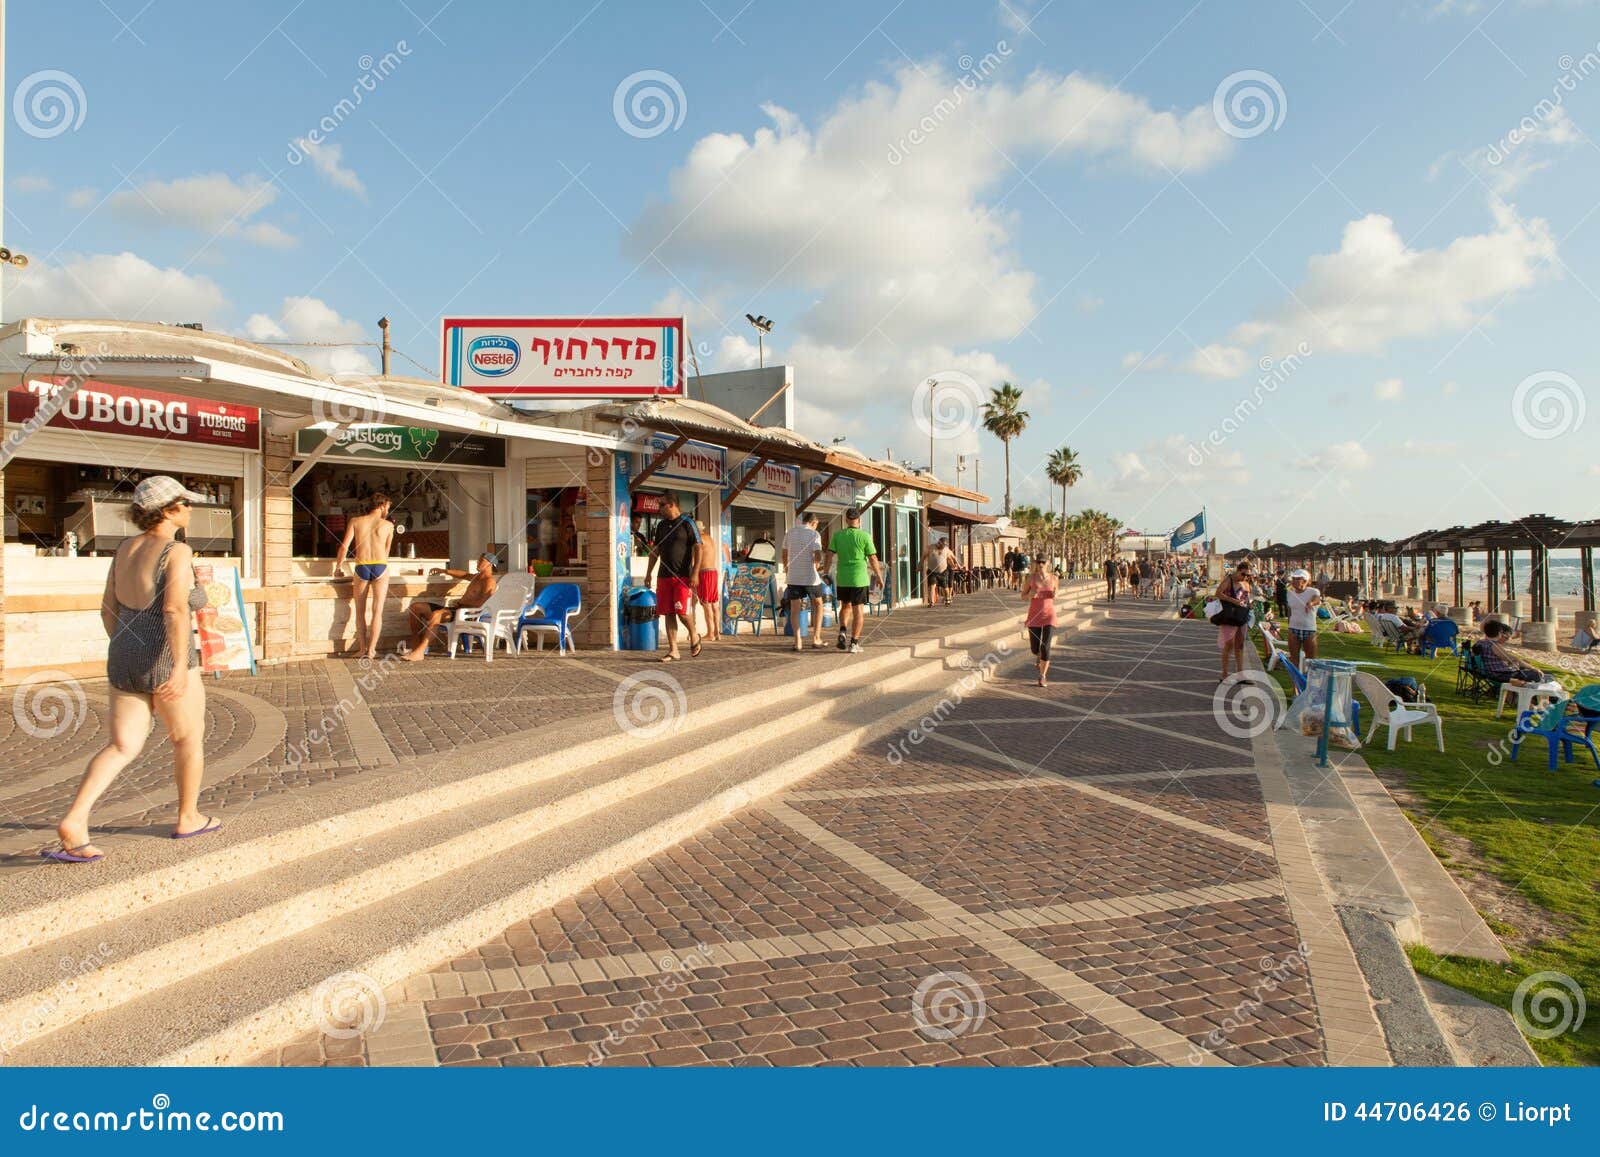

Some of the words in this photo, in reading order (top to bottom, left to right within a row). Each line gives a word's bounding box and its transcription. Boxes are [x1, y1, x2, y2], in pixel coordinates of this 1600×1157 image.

[480, 338, 508, 347] גלידות
[531, 337, 657, 366] מדרחוף
[553, 366, 602, 378] לחברים
[605, 369, 633, 380] קפה
[197, 410, 246, 433] TUBORG
